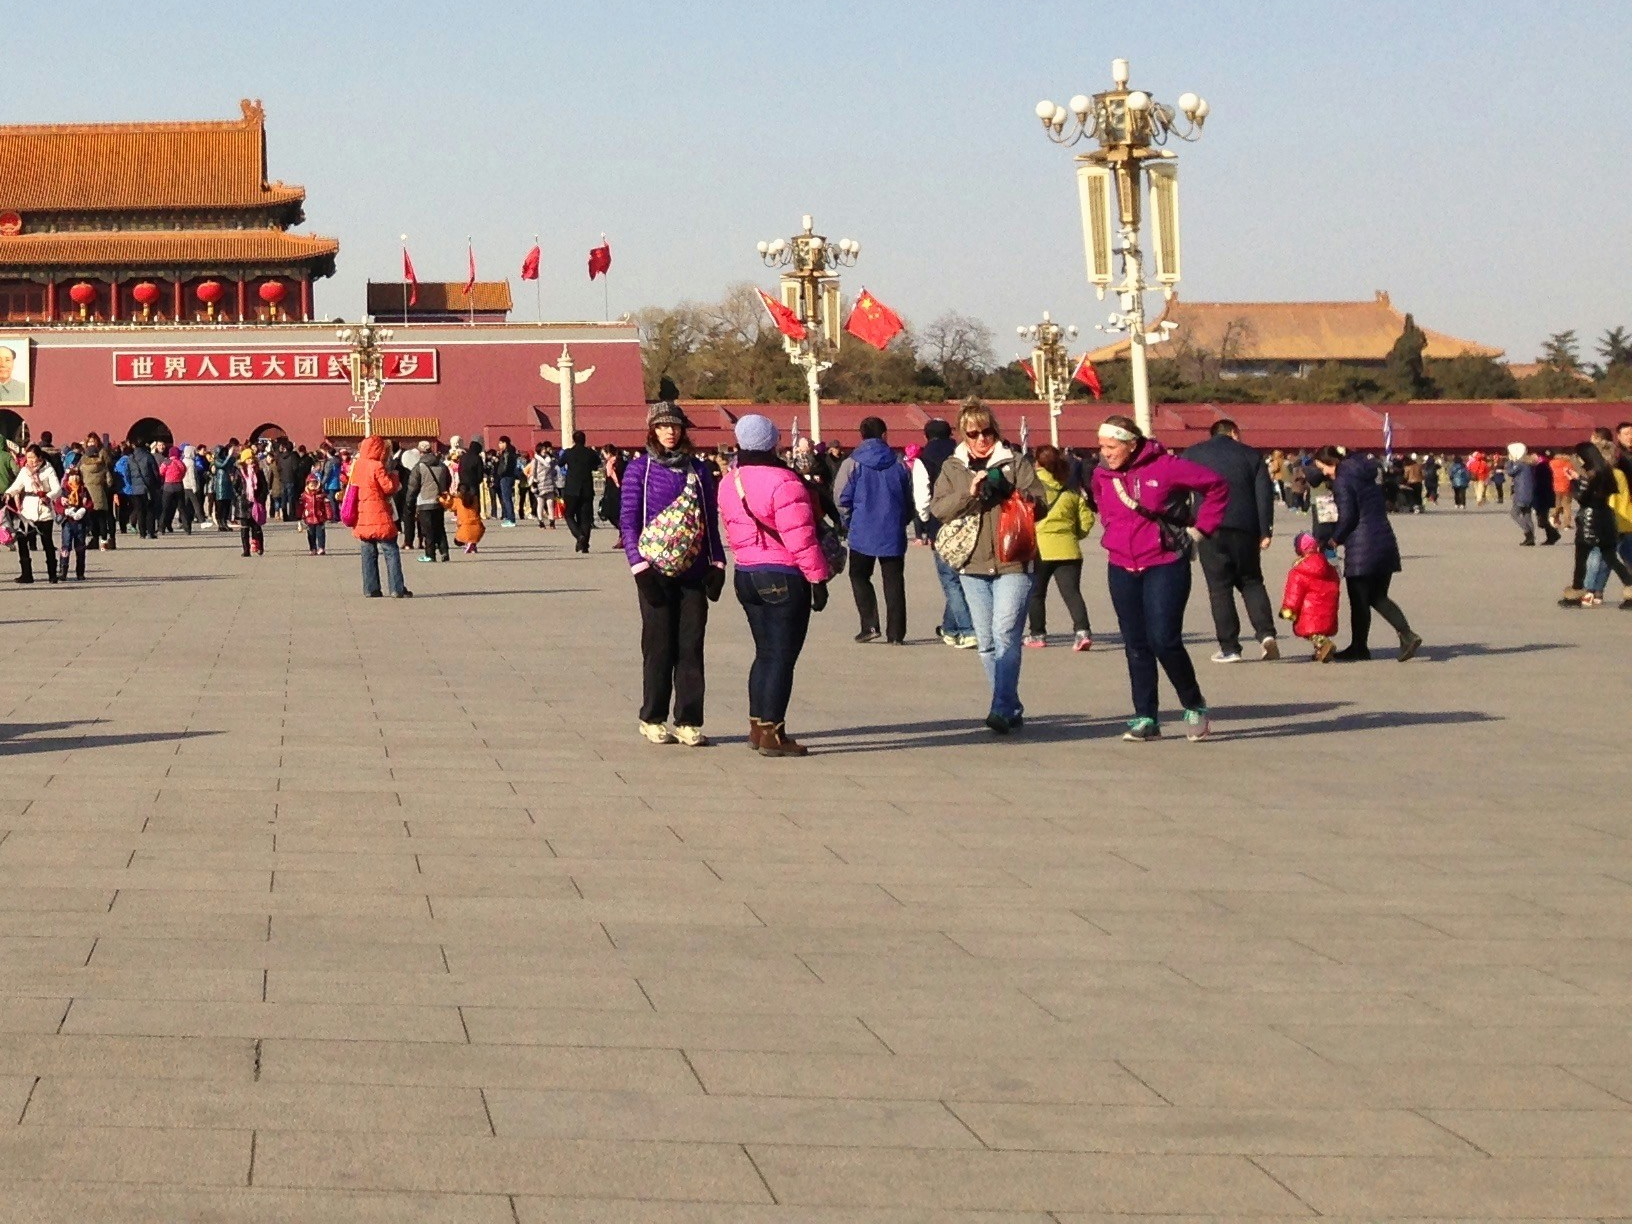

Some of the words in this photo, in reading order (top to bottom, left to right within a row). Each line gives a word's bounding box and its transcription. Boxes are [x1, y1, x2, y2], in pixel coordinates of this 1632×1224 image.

[131, 355, 419, 377] 世界人民大团结岁
